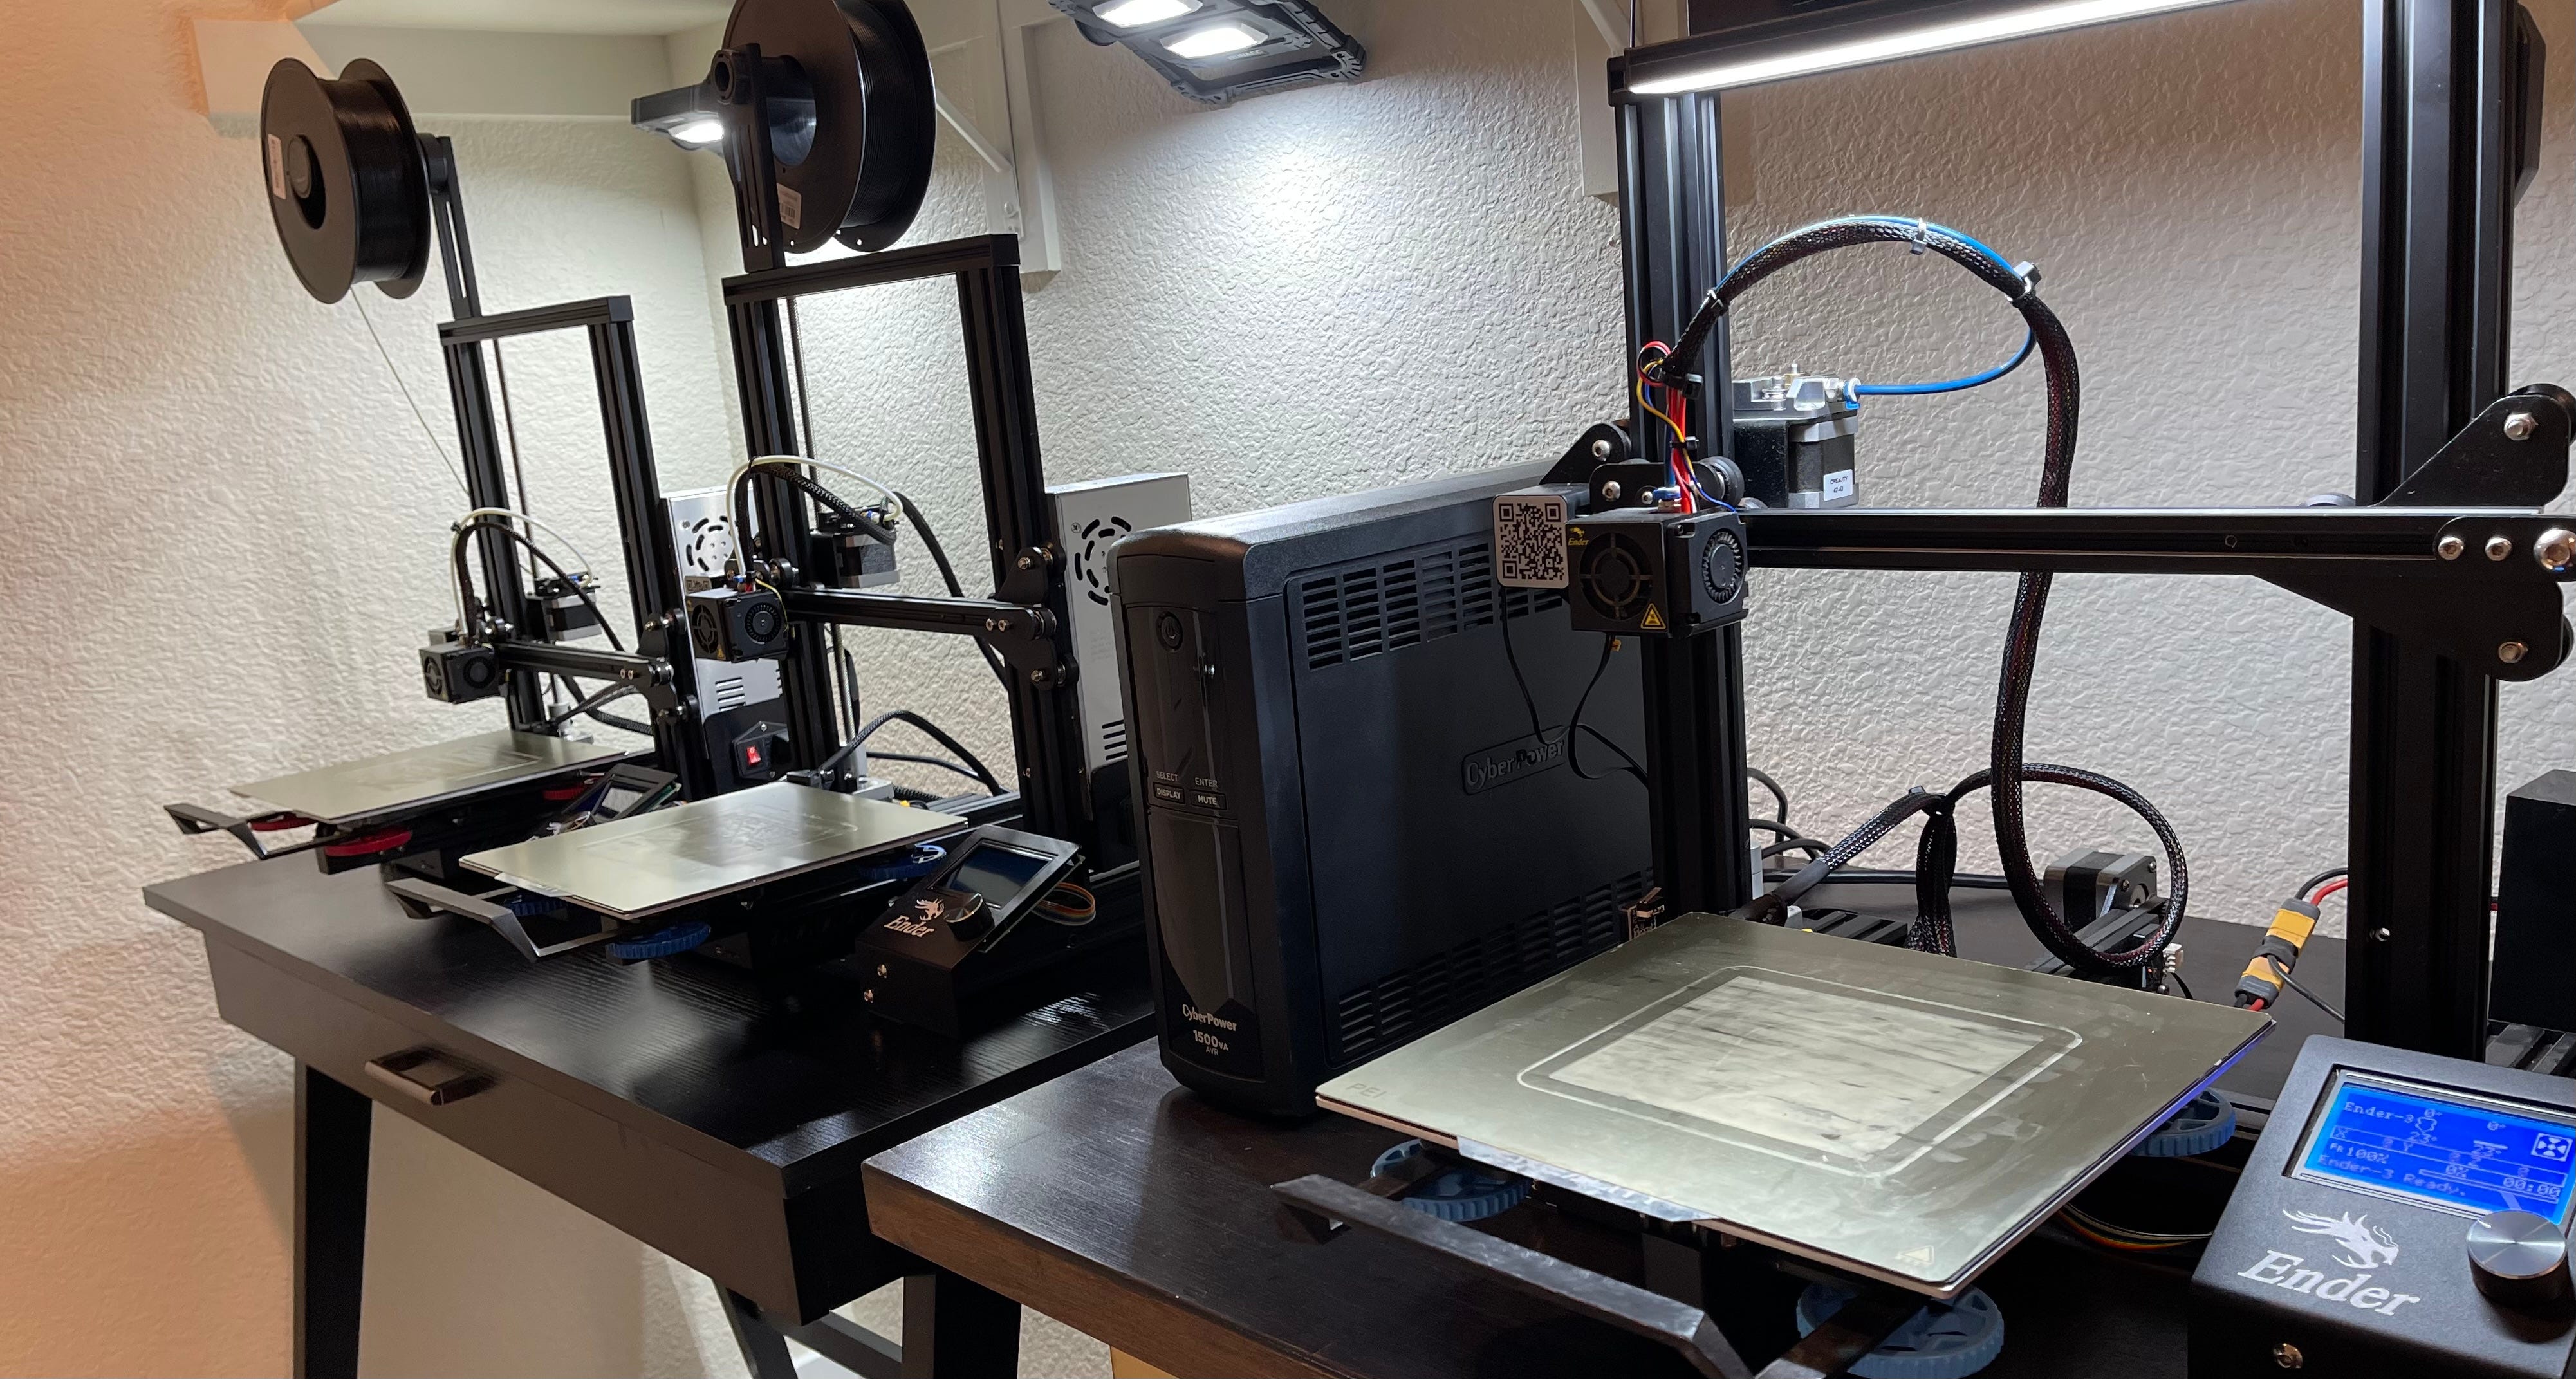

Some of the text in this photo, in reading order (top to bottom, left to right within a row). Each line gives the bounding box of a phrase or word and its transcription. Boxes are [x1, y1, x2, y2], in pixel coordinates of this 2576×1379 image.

[1467, 740, 1564, 790] CyberPower
[1156, 771, 1218, 788] SELECT ENTER
[1156, 788, 1218, 806] DISPLAY MUTE
[884, 915, 935, 938] Ender
[1182, 1004, 1237, 1031] CyberPower
[1205, 1046, 1219, 1055] AVR
[1346, 1083, 1387, 1098] PEI
[2343, 1102, 2414, 1124] Ender-3
[2318, 1154, 2466, 1196] Ender-3 Ready.
[2446, 1165, 2469, 1179] 0%
[2503, 1177, 2561, 1198] 00:00
[2237, 1250, 2421, 1315] Ender
